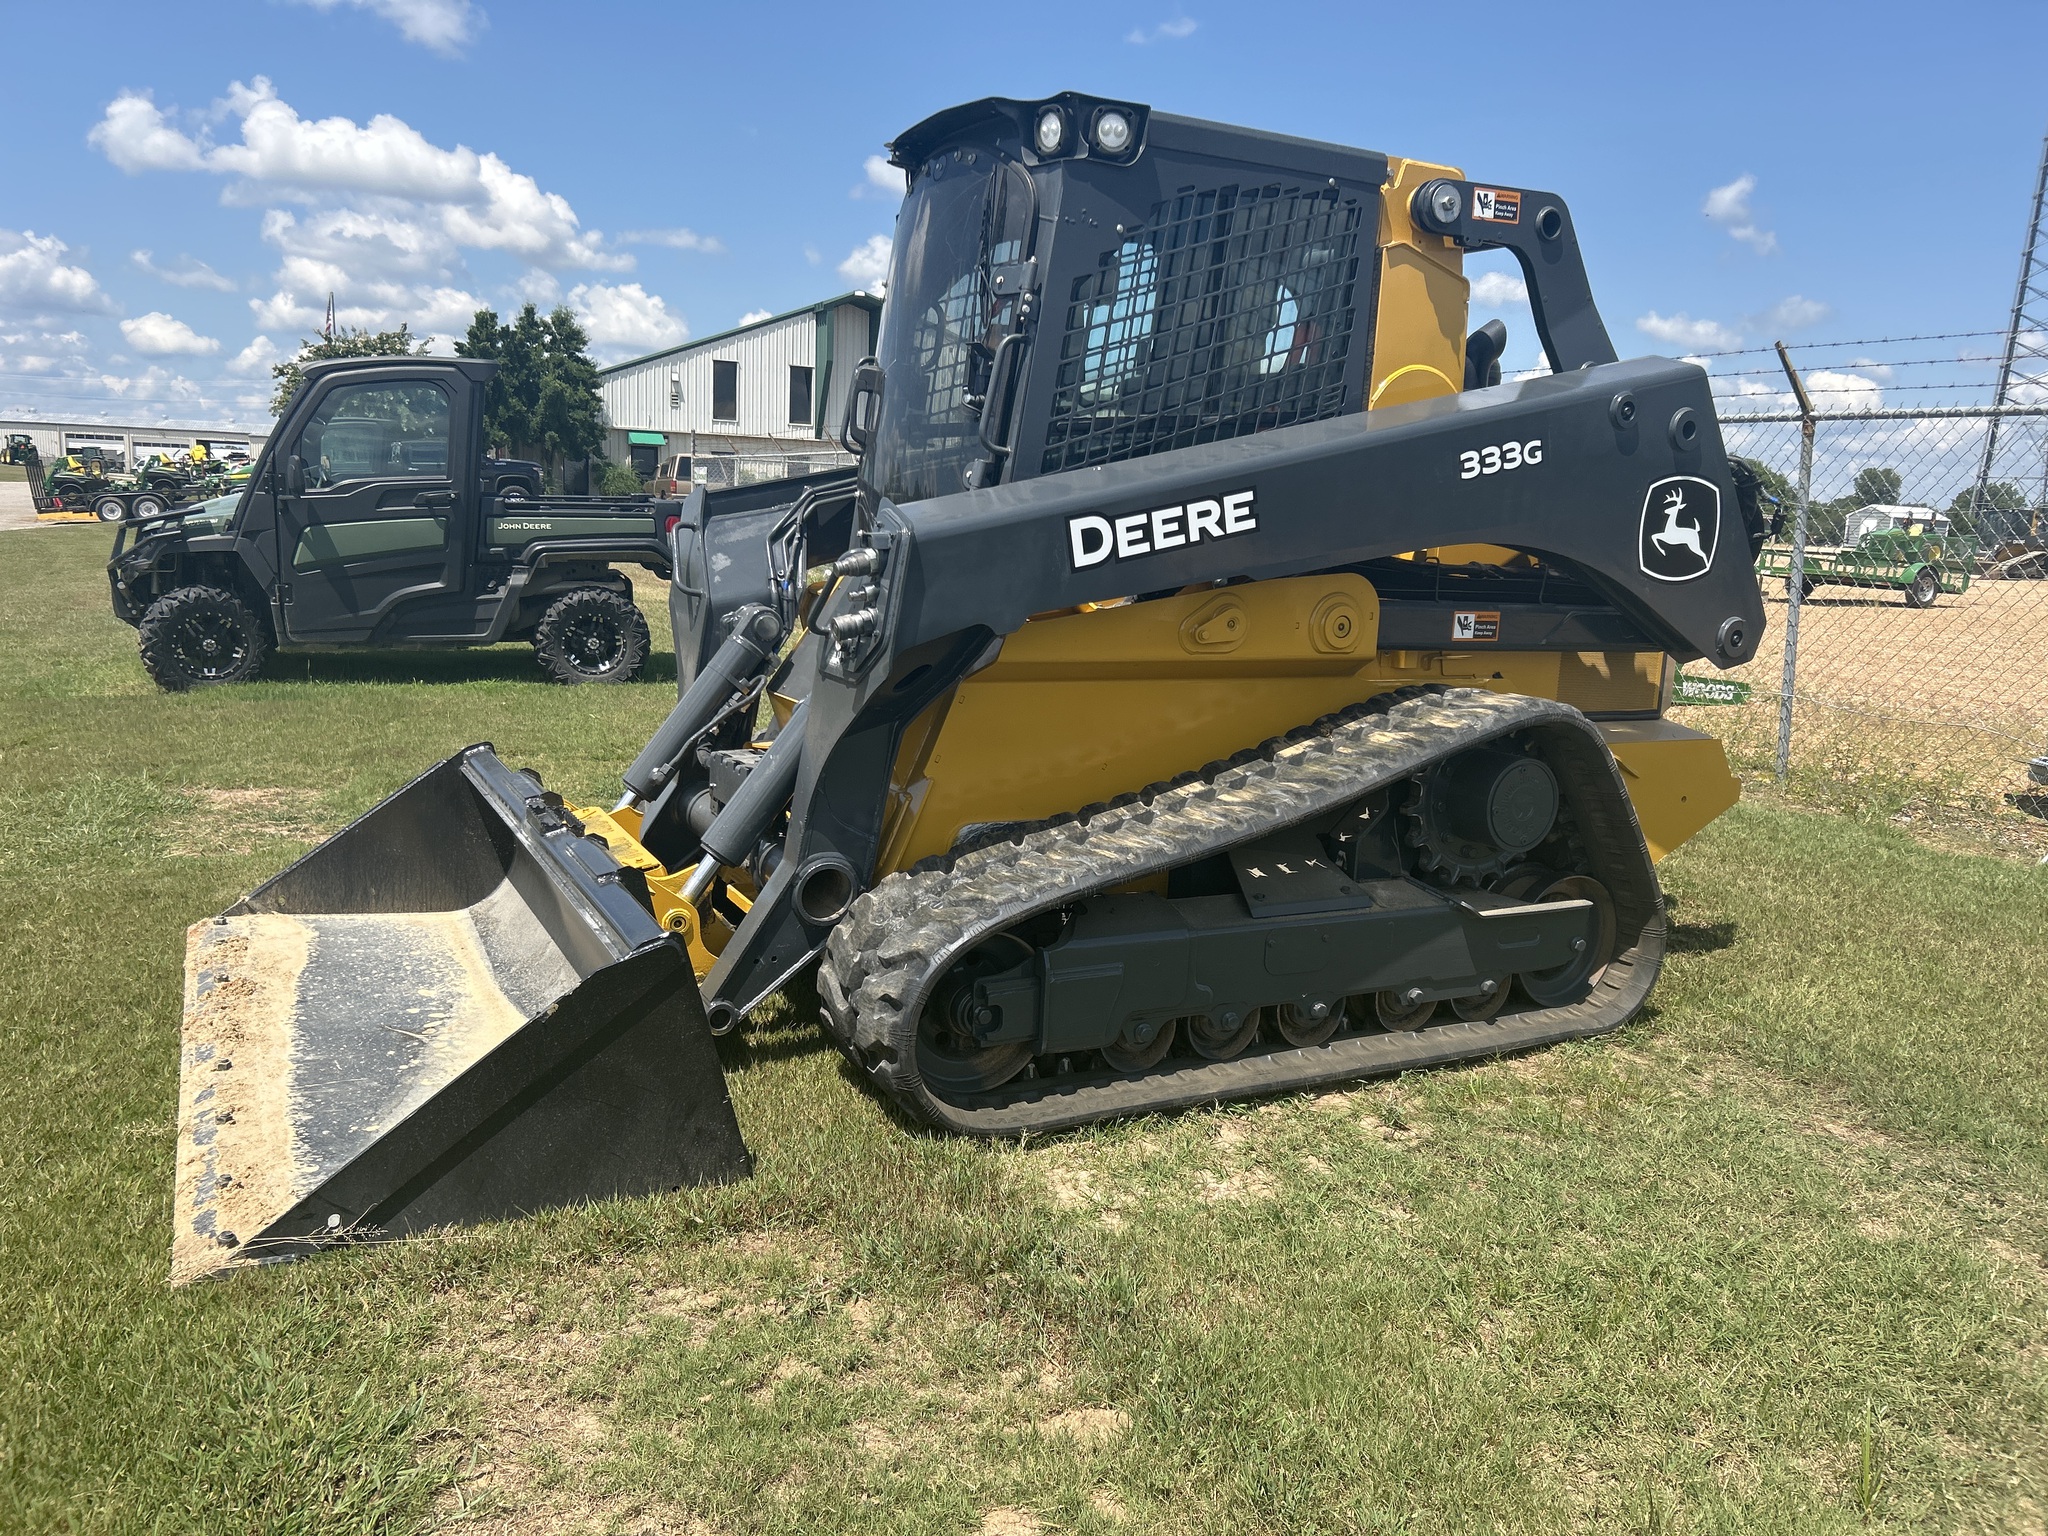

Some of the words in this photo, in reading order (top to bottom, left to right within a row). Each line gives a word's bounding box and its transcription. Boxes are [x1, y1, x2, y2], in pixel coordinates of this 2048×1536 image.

[1460, 440, 1542, 479] 333G
[498, 522, 522, 530] JOHN
[522, 522, 552, 530] DEERE
[1069, 490, 1256, 568] DEERE
